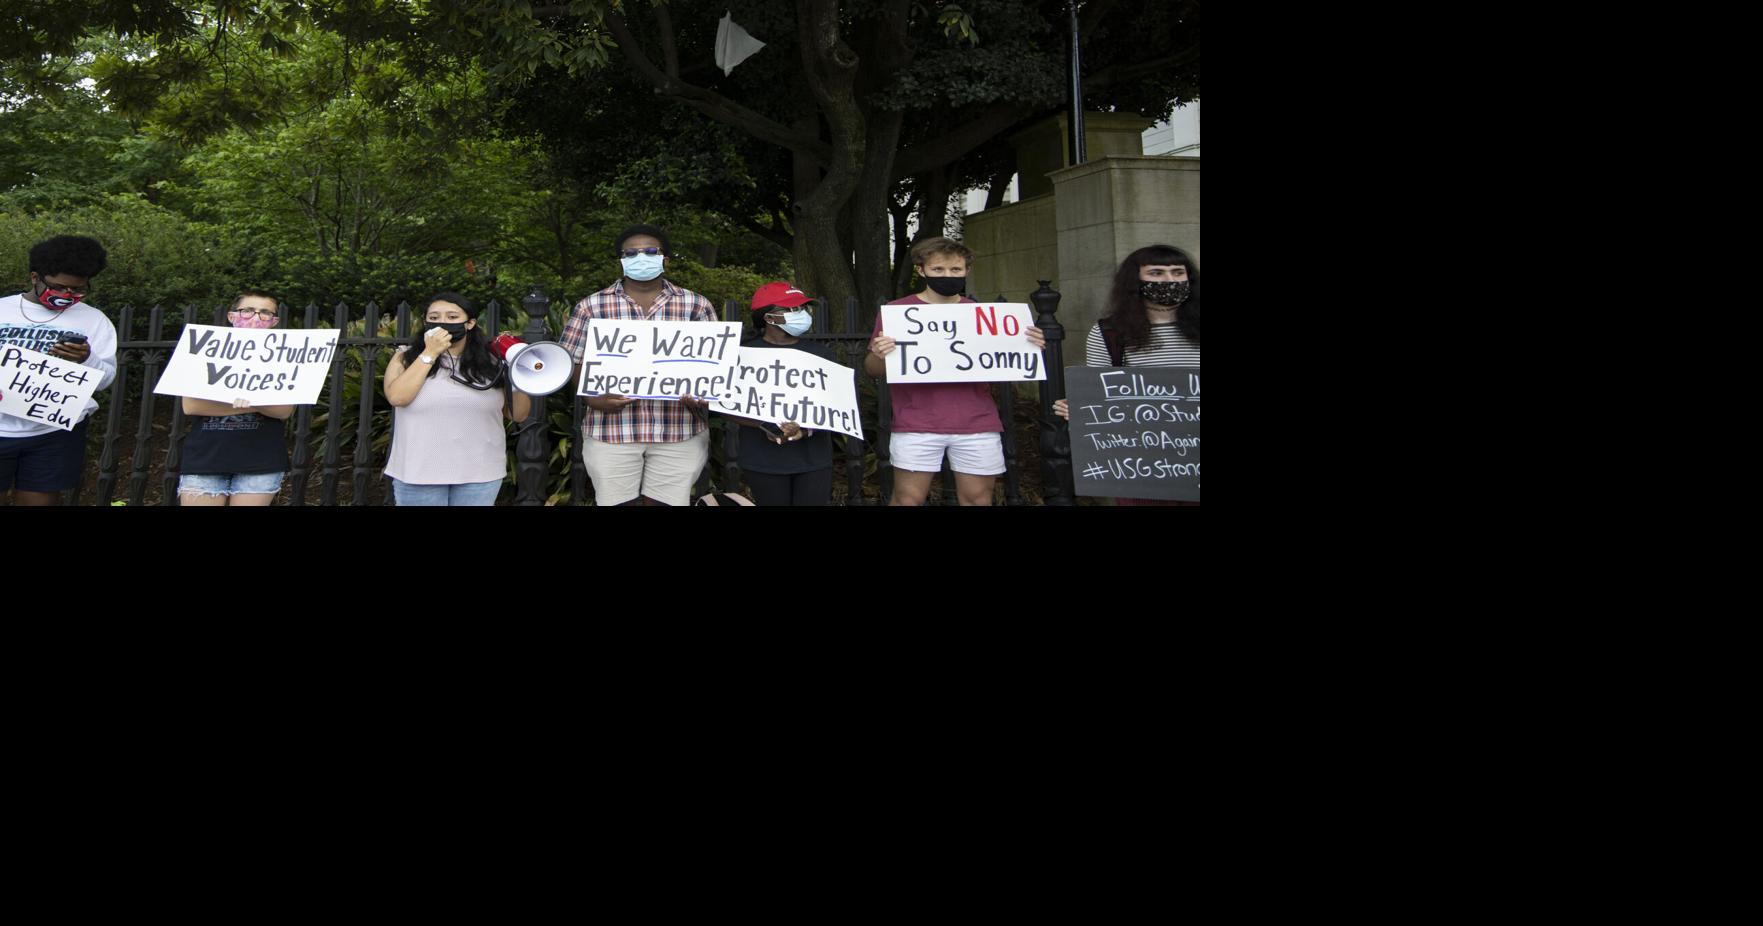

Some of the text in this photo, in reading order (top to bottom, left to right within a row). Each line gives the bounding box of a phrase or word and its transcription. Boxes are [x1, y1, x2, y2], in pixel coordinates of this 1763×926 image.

[0, 327, 83, 341] COLLUSI
[904, 306, 1020, 340] Say No
[189, 329, 336, 364] Value Student
[593, 325, 736, 361] We Want
[895, 340, 1039, 379] To Sonny
[1, 348, 88, 386] Protect
[206, 362, 298, 391] Voices!
[582, 361, 735, 399] Experience!
[737, 355, 828, 391] rotect
[1100, 370, 1177, 398] Follow
[9, 371, 78, 405] Higher
[26, 403, 71, 428] Edu
[770, 393, 860, 436] Future!
